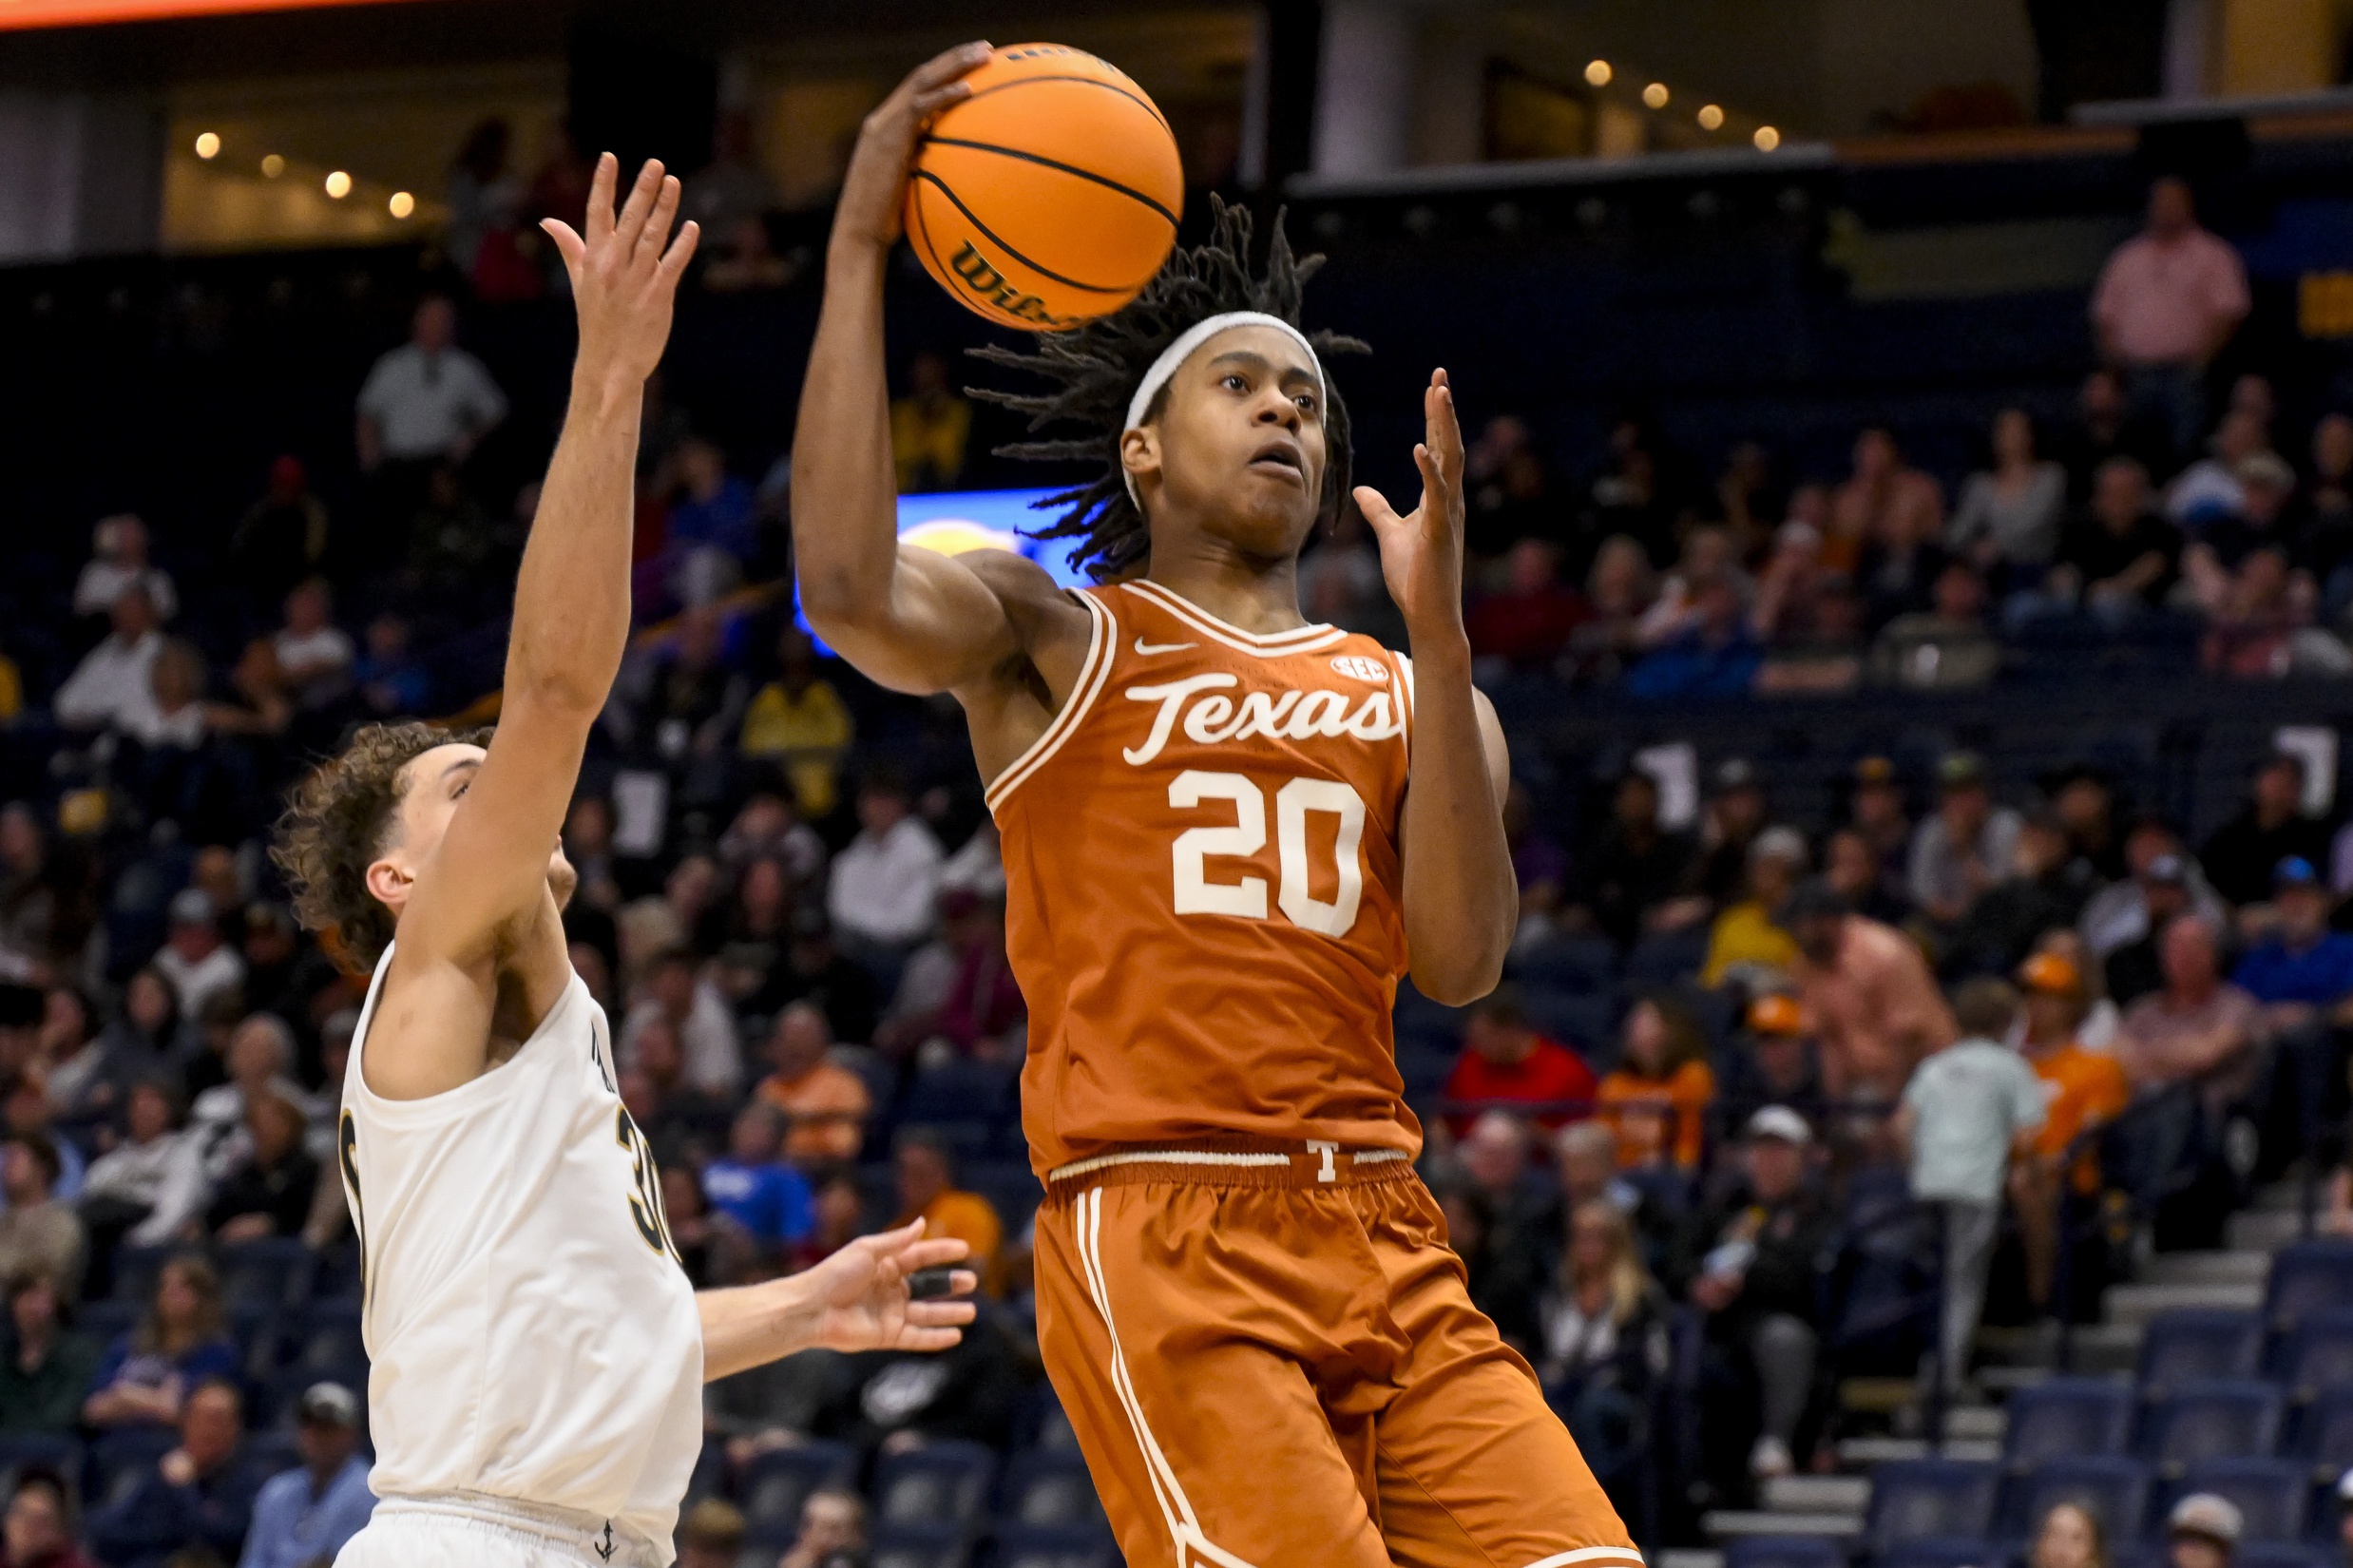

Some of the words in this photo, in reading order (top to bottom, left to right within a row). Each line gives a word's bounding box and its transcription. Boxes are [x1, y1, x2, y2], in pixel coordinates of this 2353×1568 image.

[1331, 656, 1388, 681] SEC
[1123, 673, 1402, 766] Texas
[1168, 770, 1367, 939] 20
[1306, 1138, 1339, 1183] T
